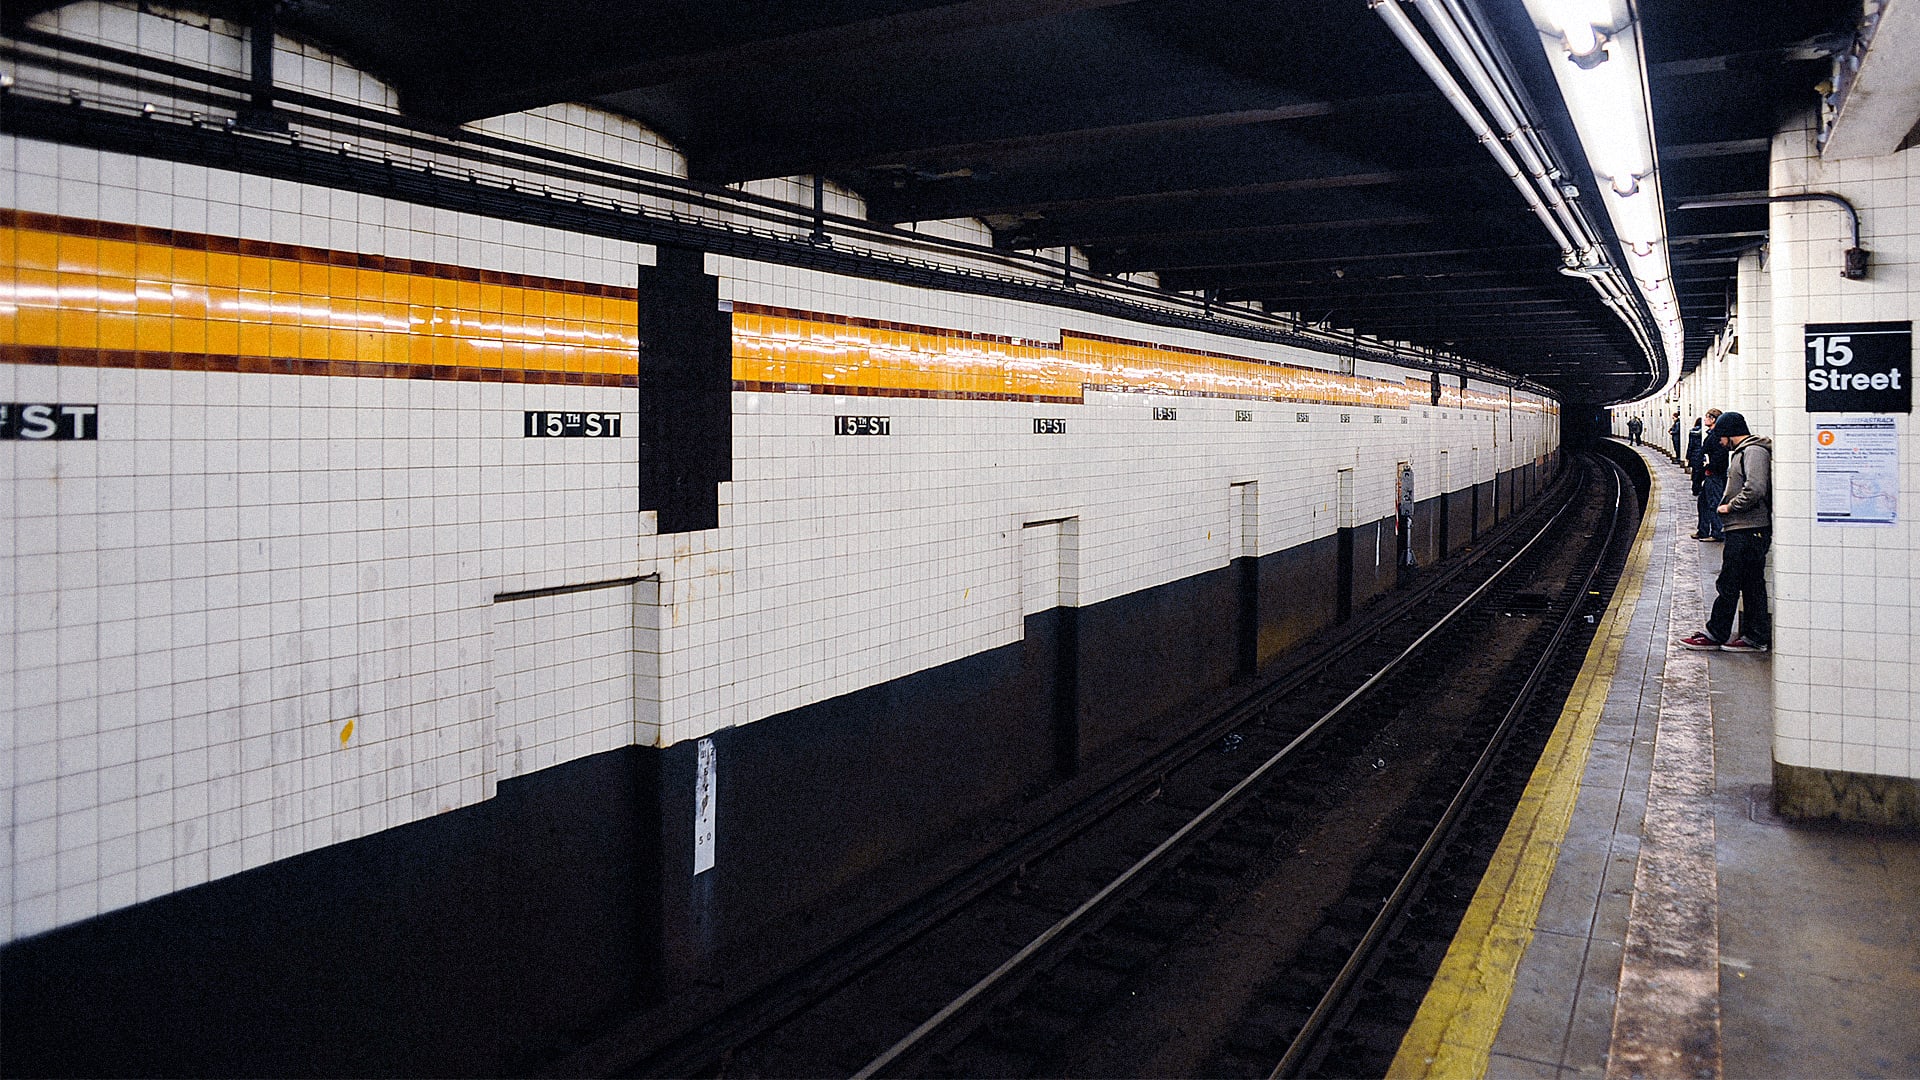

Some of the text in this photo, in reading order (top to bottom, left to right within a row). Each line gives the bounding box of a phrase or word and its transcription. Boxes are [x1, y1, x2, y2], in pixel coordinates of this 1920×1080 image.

[1807, 336, 1853, 366] 15
[1807, 368, 1901, 391] Street
[20, 405, 96, 439] ST
[531, 412, 620, 437] 15TH ST
[869, 417, 890, 435] ST
[1053, 419, 1066, 433] ST
